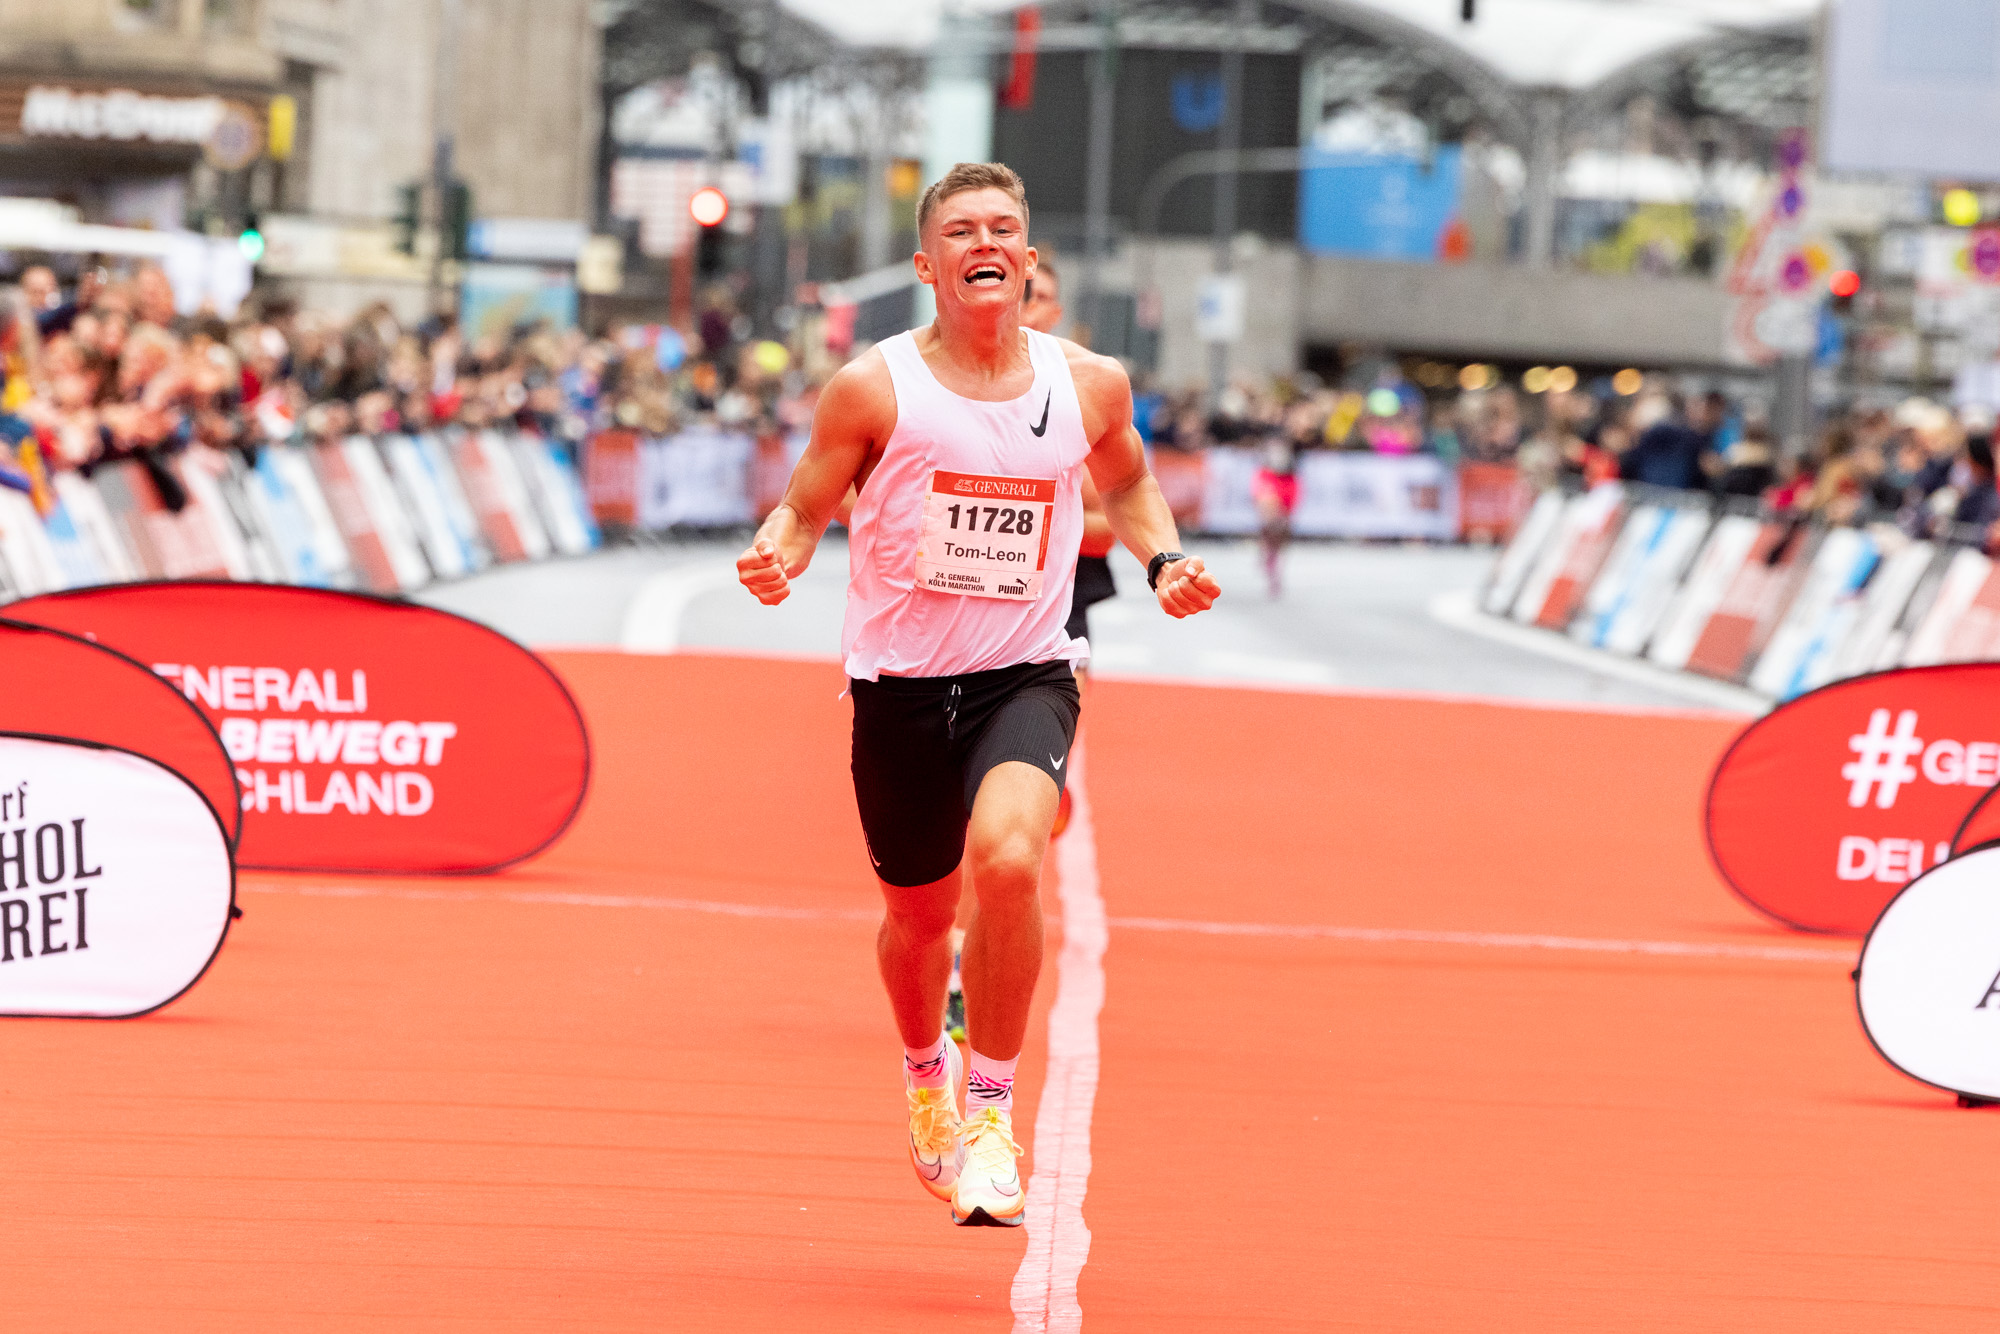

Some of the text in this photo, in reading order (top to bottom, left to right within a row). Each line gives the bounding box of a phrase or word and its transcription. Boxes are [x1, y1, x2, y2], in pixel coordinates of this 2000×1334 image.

[975, 480, 1037, 497] GENERALI
[948, 504, 1034, 535] 11728
[944, 542, 1026, 563] Tom-Leon
[928, 578, 985, 592] KÖLN MARATHON
[935, 571, 981, 583] 24. GENERALI
[998, 584, 1024, 596] PUMA
[220, 717, 457, 766] BEWEGT
[1841, 708, 2000, 809] #GE
[0, 818, 102, 892] HOL
[0, 888, 89, 962] REI
